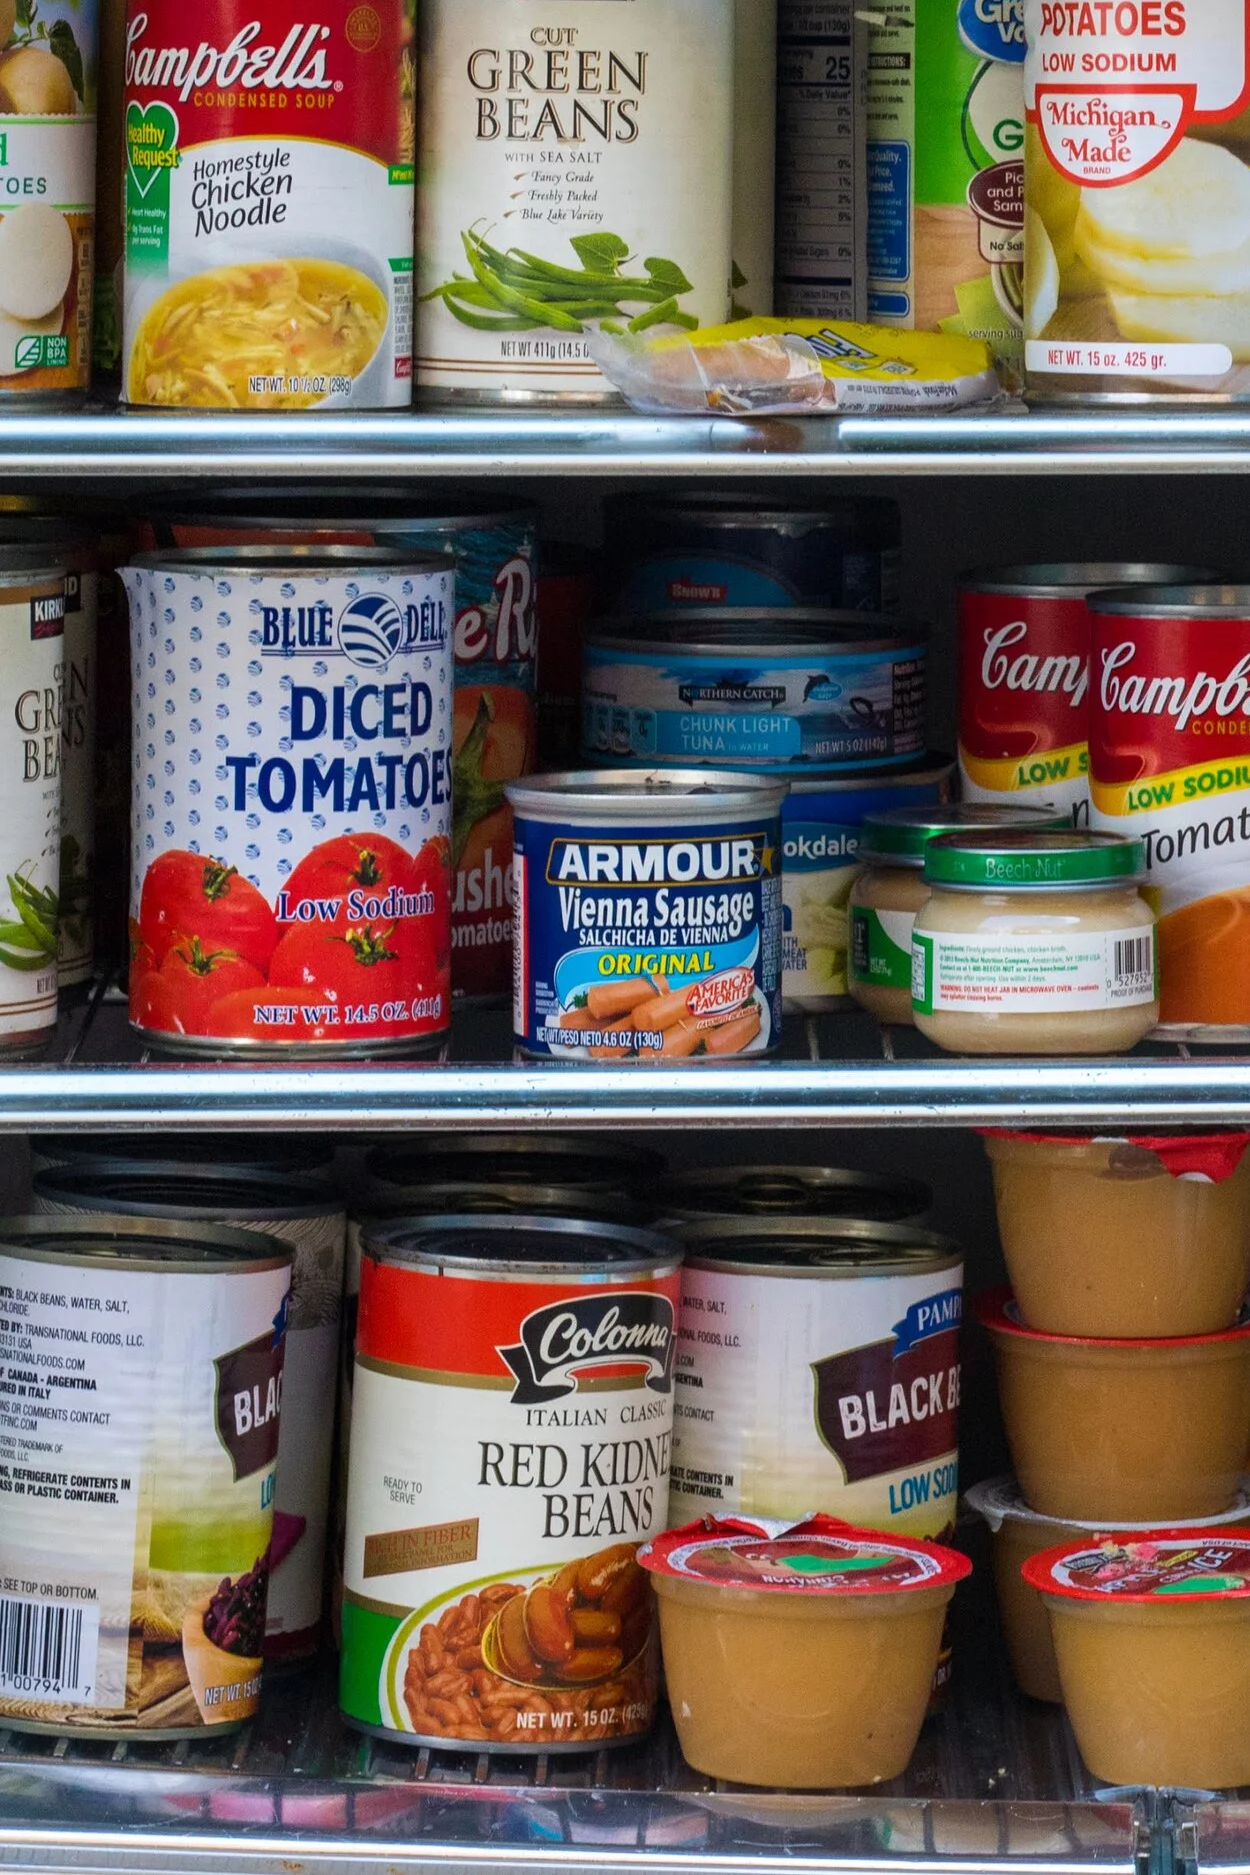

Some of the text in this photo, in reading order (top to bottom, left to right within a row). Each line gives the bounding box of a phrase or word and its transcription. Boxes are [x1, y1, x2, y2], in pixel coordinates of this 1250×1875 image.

[1040, 1, 1186, 36] POTATOES
[530, 28, 578, 47] CUT
[126, 13, 332, 102] Campbell's
[467, 49, 648, 95] GREEN
[1043, 54, 1177, 72] LOW SODIUM
[193, 93, 334, 109] CONDENSED SOUP
[1047, 98, 1171, 134] Michigan
[128, 124, 165, 147] Healthy
[475, 97, 640, 143] BEANS
[133, 147, 178, 169] Request
[505, 152, 602, 164] WITH SEA SALT
[1062, 128, 1131, 163] Made
[193, 148, 290, 181] Homestyle
[1083, 167, 1111, 175] BRAND
[192, 173, 292, 210] Chicken
[195, 197, 287, 237] Noodle
[262, 602, 444, 646] BLUE DELL
[291, 682, 432, 741] DICED
[680, 716, 790, 733] CHUNK LIGHT
[682, 736, 725, 751] TUNA
[1128, 783, 1176, 810] LOW
[558, 840, 754, 882] ARMOUR
[277, 885, 434, 922] Low Sodium
[558, 886, 649, 933] Vienna
[653, 887, 754, 938] Sausage
[579, 926, 728, 945] SALCHICHA DE VIENNA
[599, 951, 715, 975] ORIGINAL
[690, 972, 754, 1003] AMERICA'S
[695, 989, 748, 1013] FAVORITE
[540, 1308, 670, 1364] Colonna
[526, 1398, 667, 1426] ITALIAN CLASSIC
[839, 1370, 944, 1440] BLACK
[478, 1430, 670, 1487] RED KIDNE
[383, 1476, 422, 1493] READY TO
[390, 1490, 415, 1505] SERVE
[889, 1477, 931, 1514] LOW
[542, 1485, 654, 1541] BEANS
